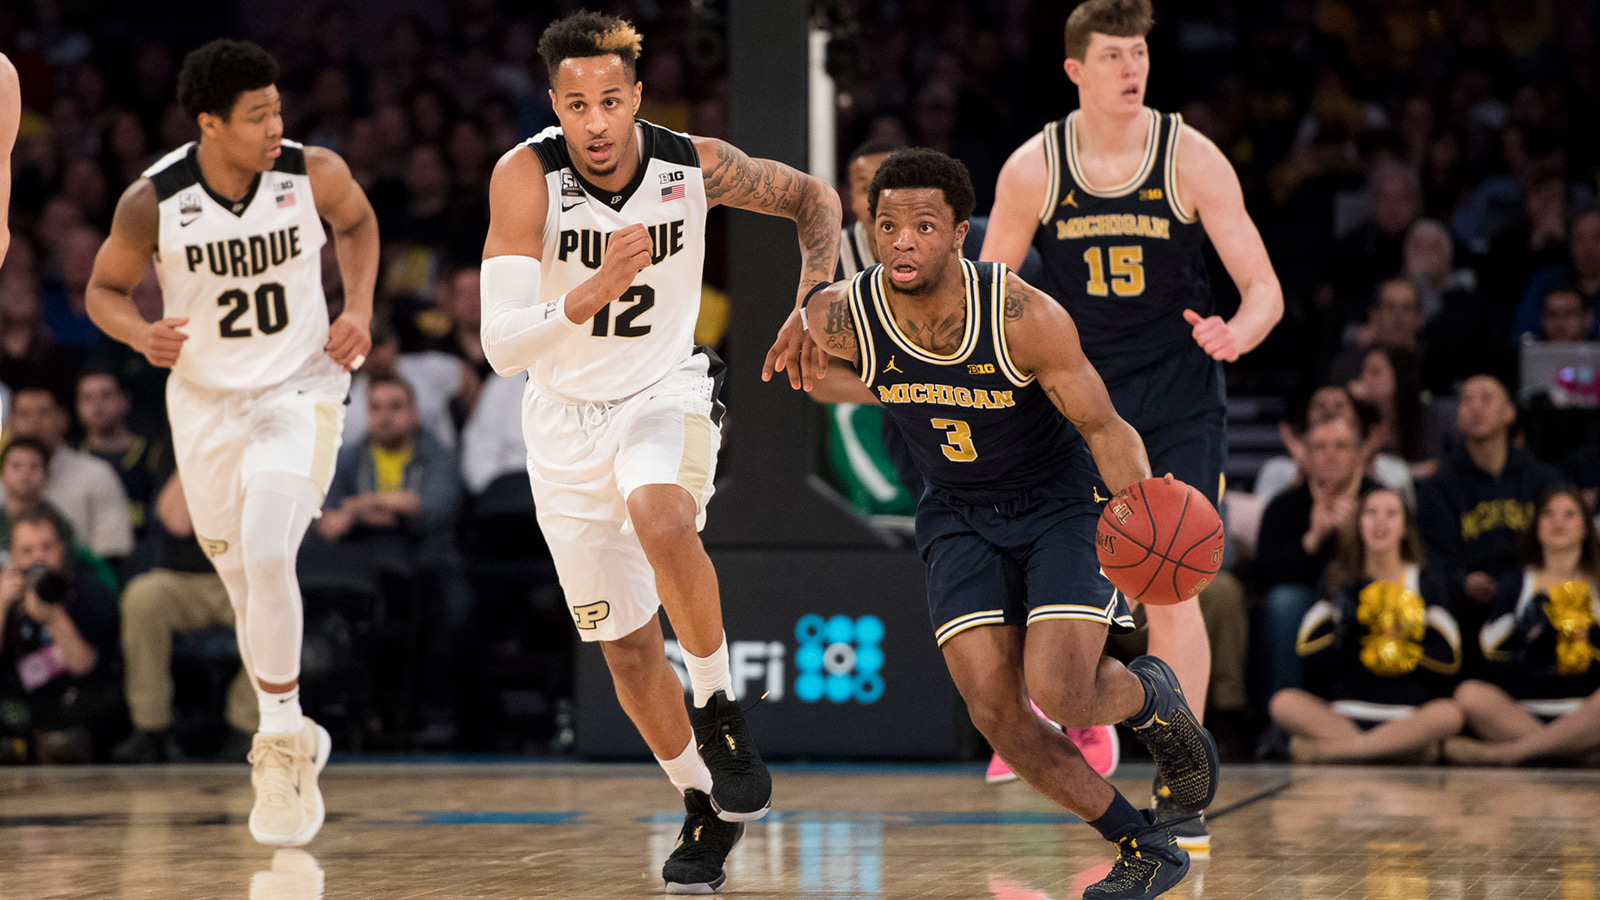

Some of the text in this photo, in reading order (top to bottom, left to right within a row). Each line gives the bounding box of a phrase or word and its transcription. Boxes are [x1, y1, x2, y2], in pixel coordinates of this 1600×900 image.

[185, 225, 302, 277] PURDUE
[558, 219, 685, 270] PUUE
[1056, 213, 1171, 240] MICHIGAN
[1083, 245, 1146, 297] 15
[216, 281, 289, 338] 20
[591, 284, 656, 338] 12
[877, 383, 1016, 410] MICHIGAN
[930, 417, 978, 462] 3
[573, 600, 611, 630] P
